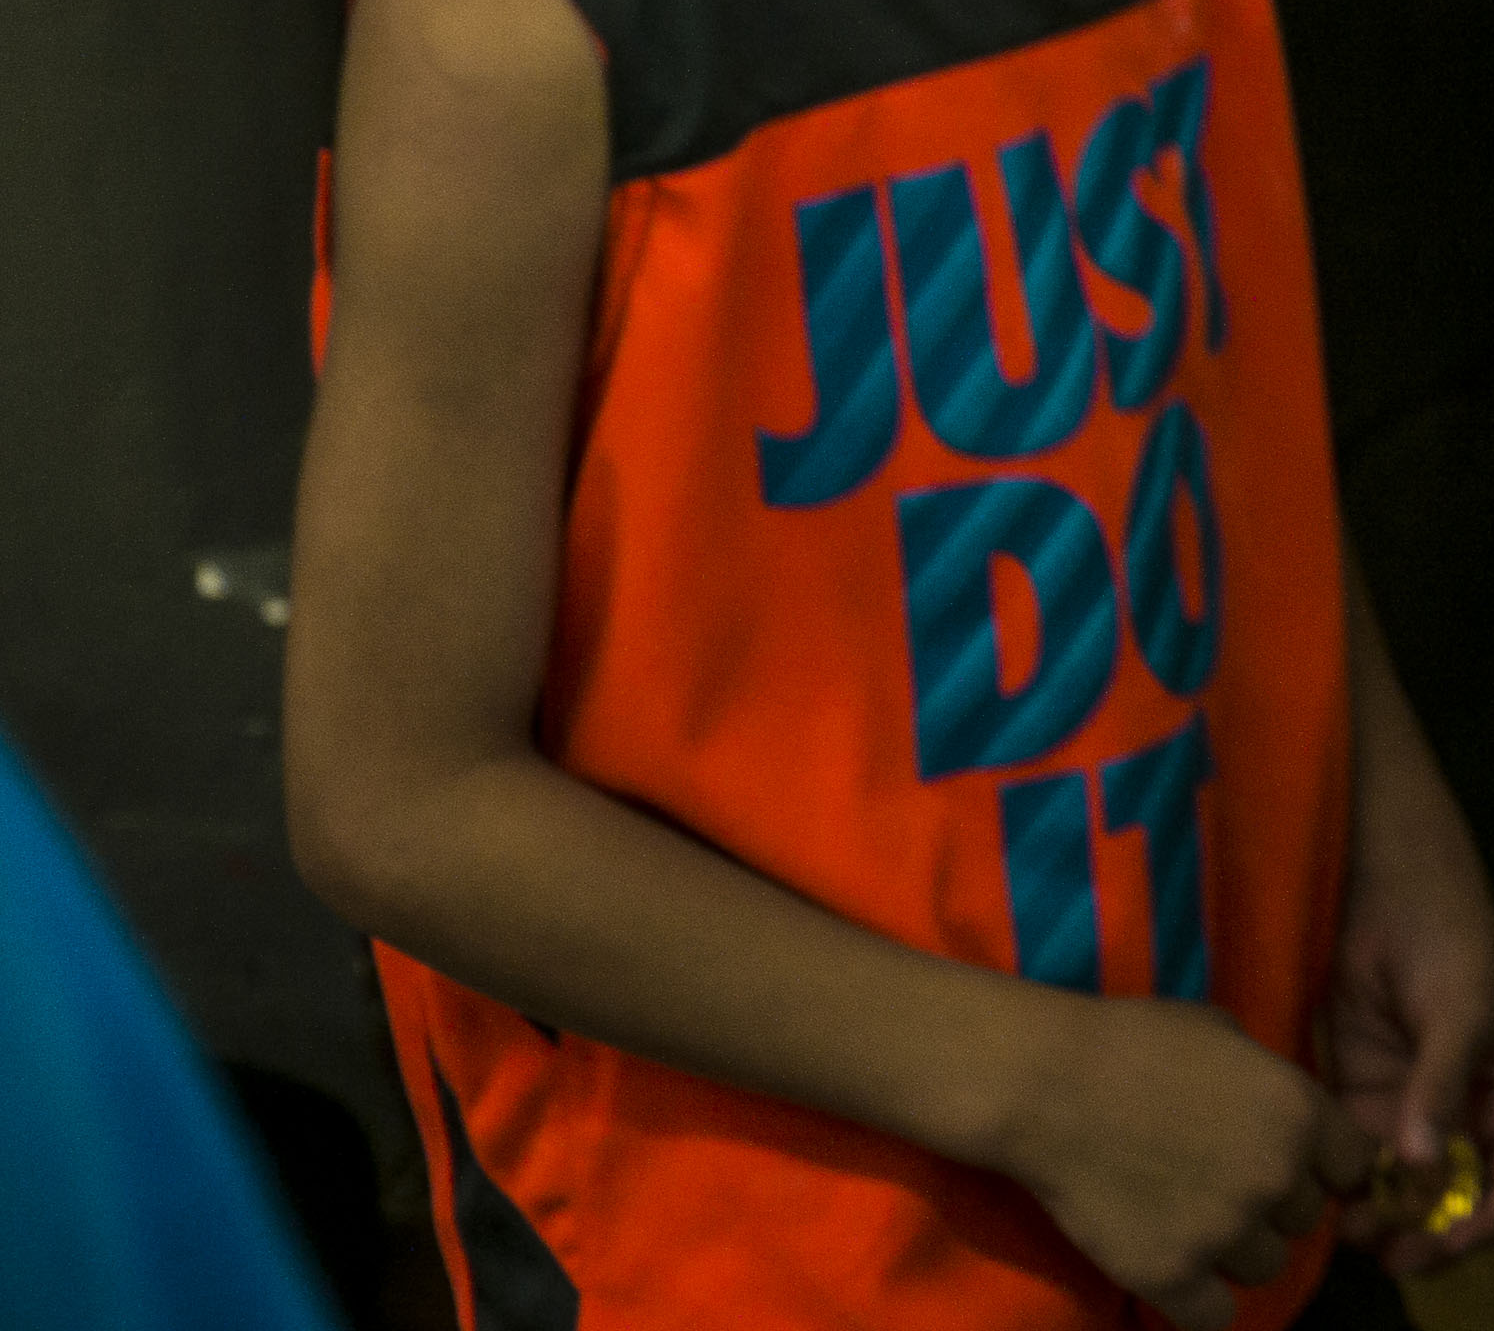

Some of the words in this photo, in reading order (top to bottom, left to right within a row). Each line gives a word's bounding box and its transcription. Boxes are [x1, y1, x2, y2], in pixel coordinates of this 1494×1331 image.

[756, 54, 1230, 509] JUST
[895, 399, 1224, 785] DO
[999, 709, 1216, 1000] IT
